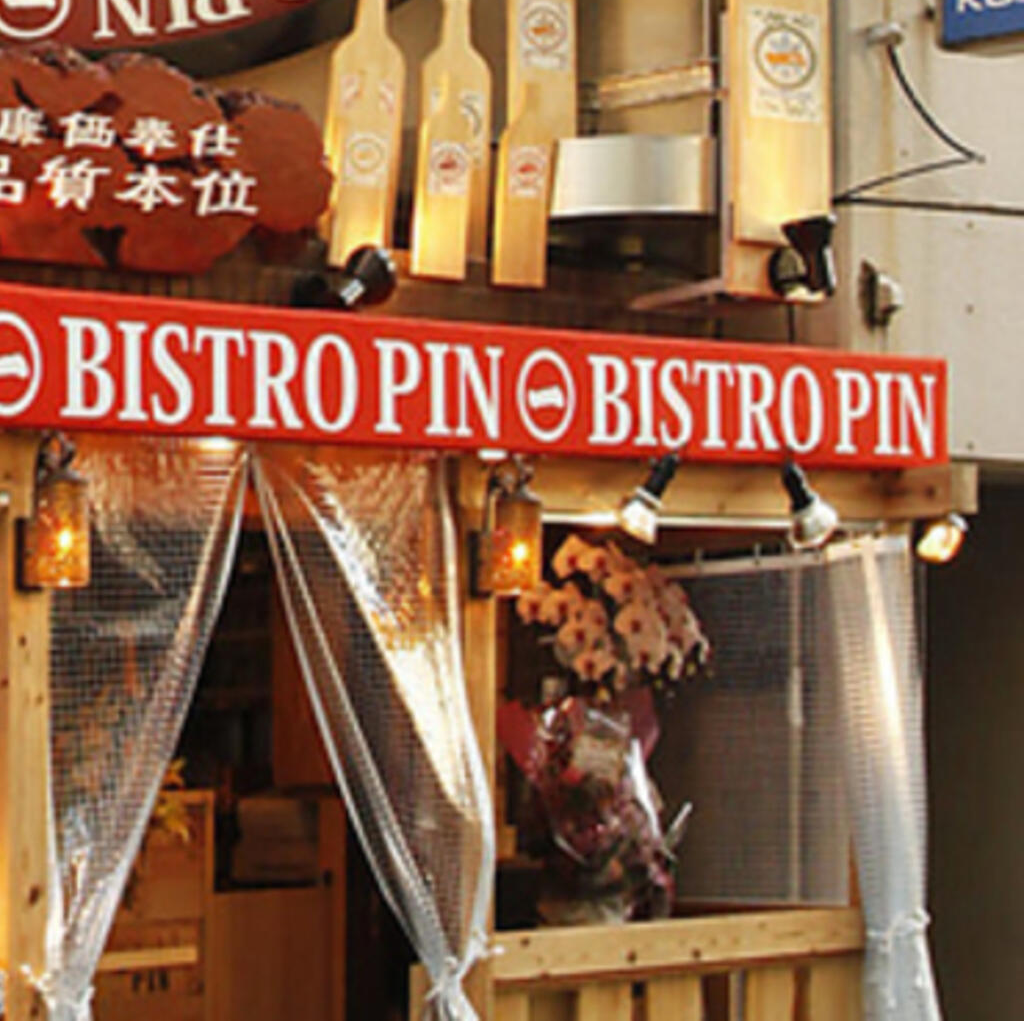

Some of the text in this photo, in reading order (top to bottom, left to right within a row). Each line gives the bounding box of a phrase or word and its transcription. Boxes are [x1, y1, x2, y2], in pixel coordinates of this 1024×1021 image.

[59, 316, 359, 433] BISTRO
[374, 339, 504, 440] PIN
[588, 355, 824, 454] BISTRO
[834, 369, 935, 459] PIN
